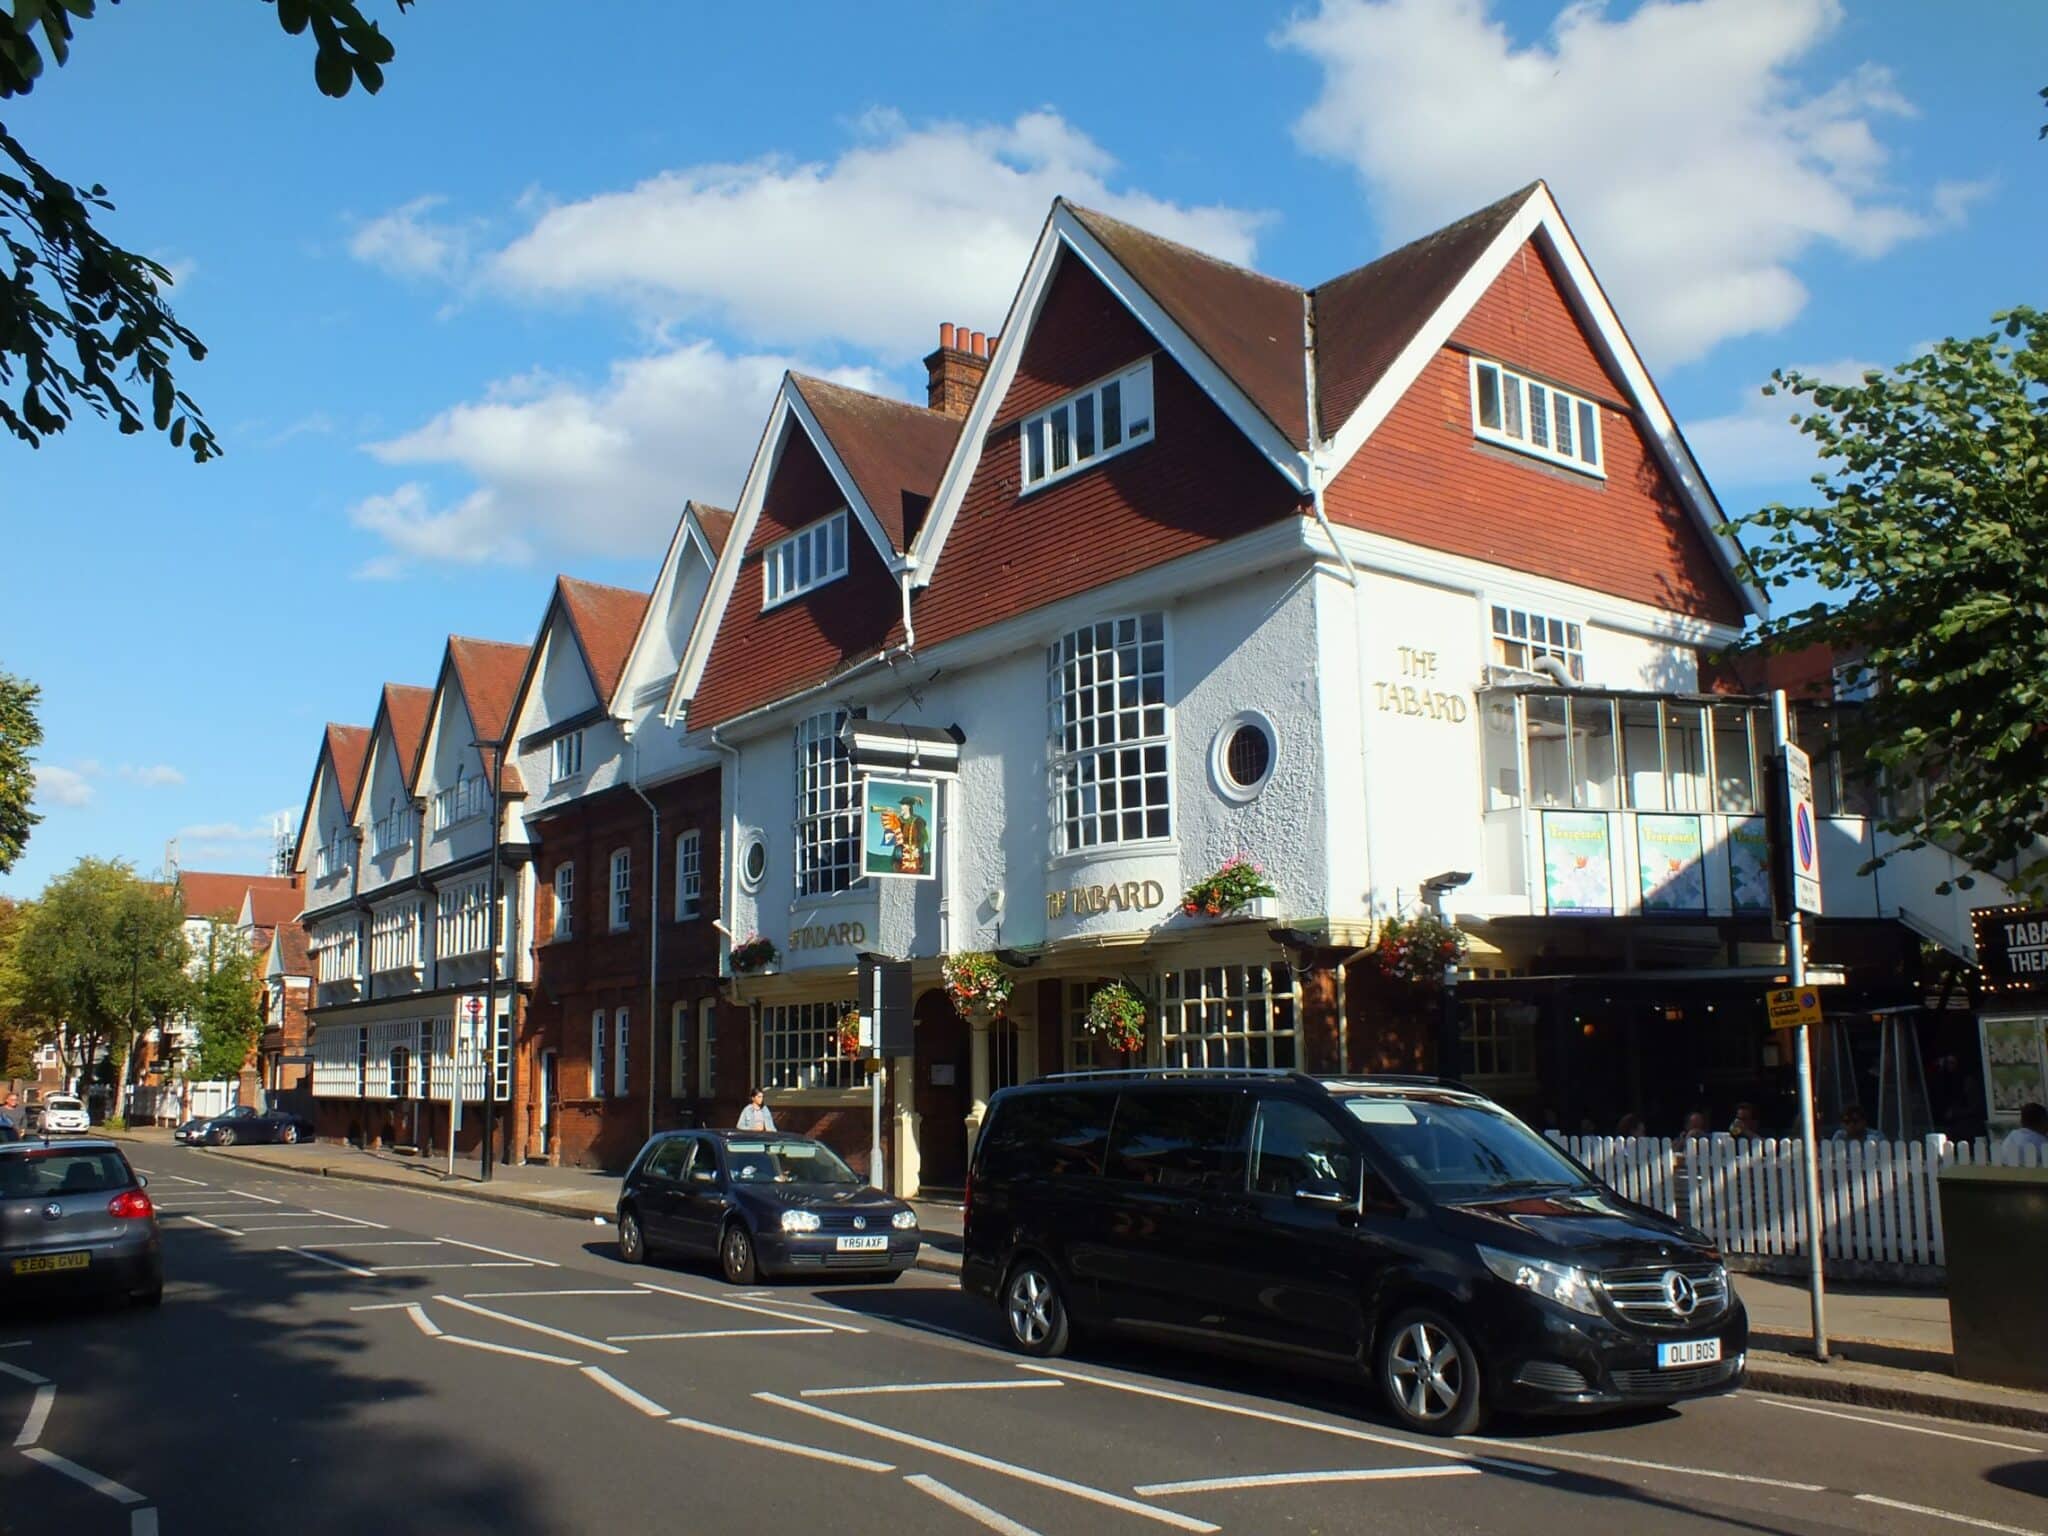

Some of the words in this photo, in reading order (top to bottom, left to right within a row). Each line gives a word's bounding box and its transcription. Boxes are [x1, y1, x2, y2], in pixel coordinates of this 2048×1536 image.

[1397, 646, 1437, 679] THE
[1373, 681, 1467, 723] TABARD
[1071, 880, 1164, 914] TABARD
[800, 921, 865, 951] TABARD
[866, 1238, 883, 1249] AXF
